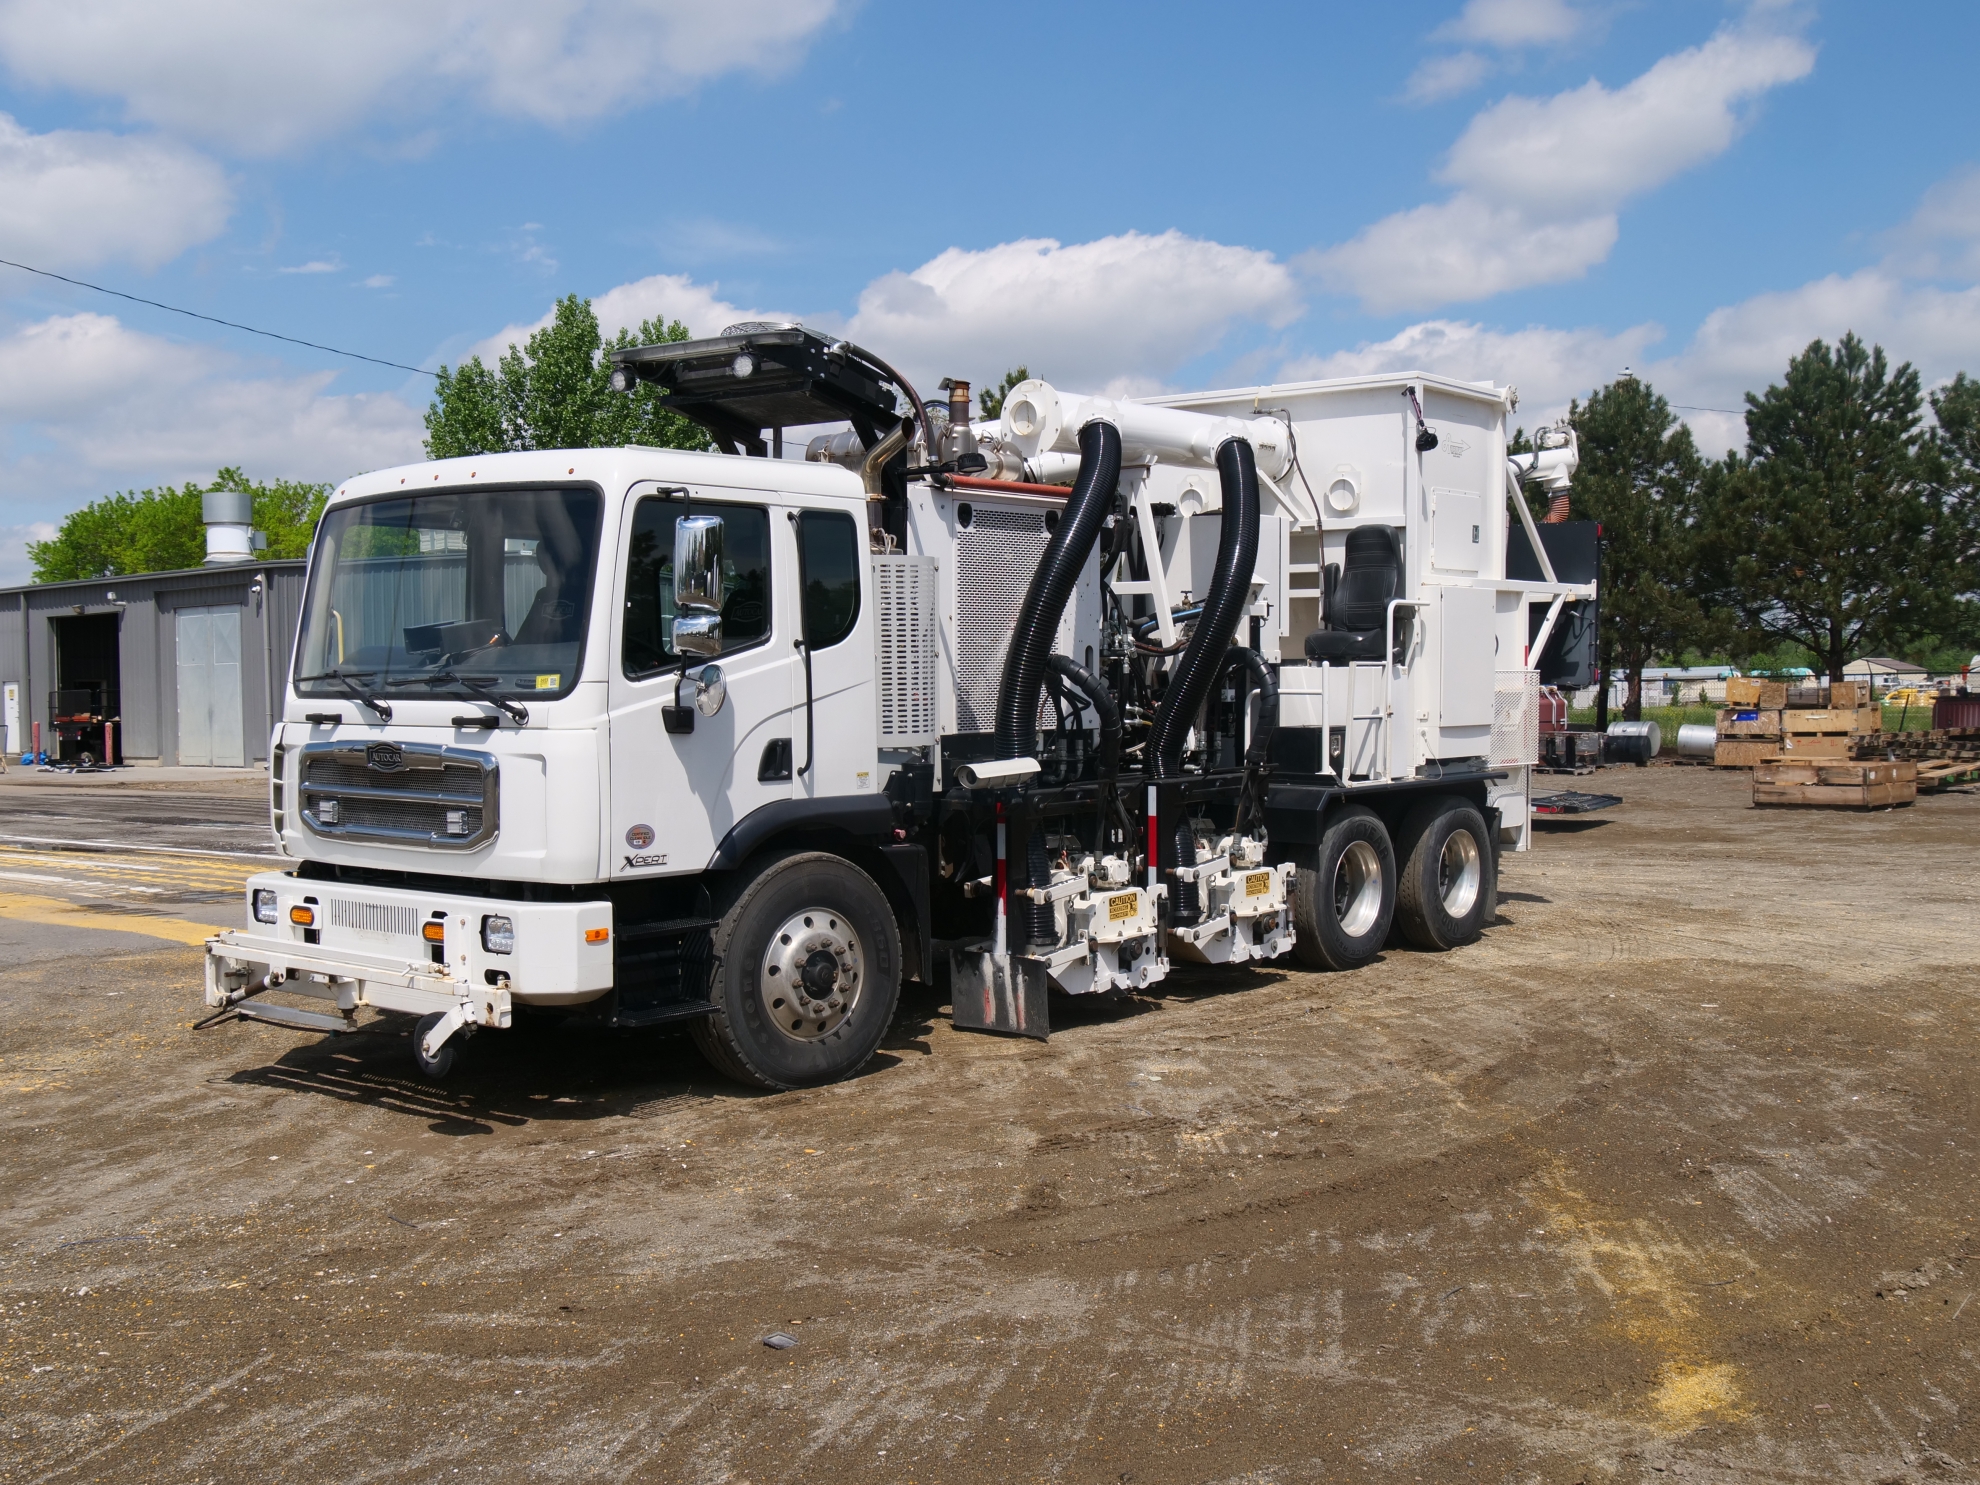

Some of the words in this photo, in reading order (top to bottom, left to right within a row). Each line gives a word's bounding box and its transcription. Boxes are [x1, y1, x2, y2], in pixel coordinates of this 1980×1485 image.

[734, 607, 763, 616] AUTOCA
[372, 752, 402, 762] AUTOCAR
[619, 853, 668, 872] XPERT
[1247, 873, 1268, 884] CAUTION
[1110, 893, 1136, 906] CAUTION
